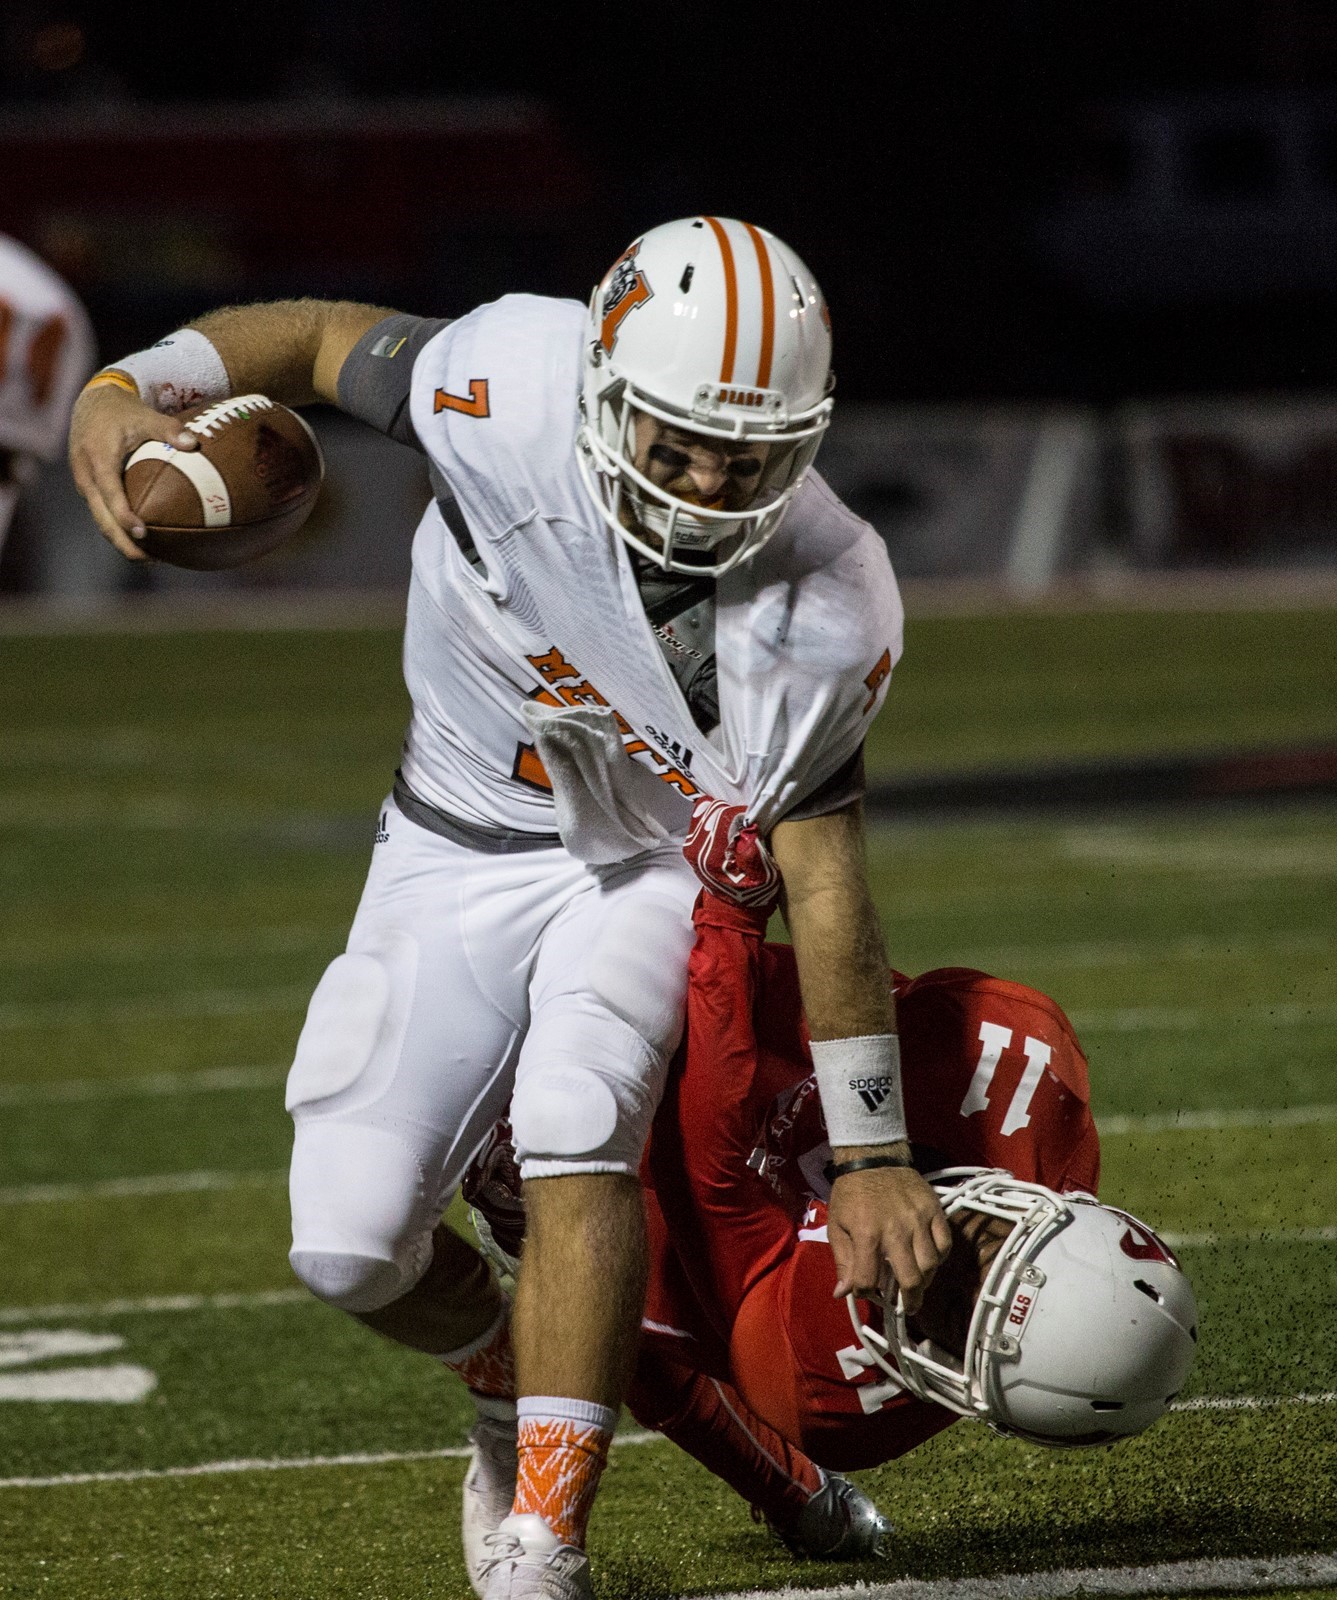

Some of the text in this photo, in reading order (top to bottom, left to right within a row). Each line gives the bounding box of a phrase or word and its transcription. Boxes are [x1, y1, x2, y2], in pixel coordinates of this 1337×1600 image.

[433, 378, 491, 418] 7
[645, 725, 695, 779] adidas
[849, 1077, 893, 1090] adidas
[960, 1021, 1052, 1137] 11
[1009, 1294, 1032, 1326] STB
